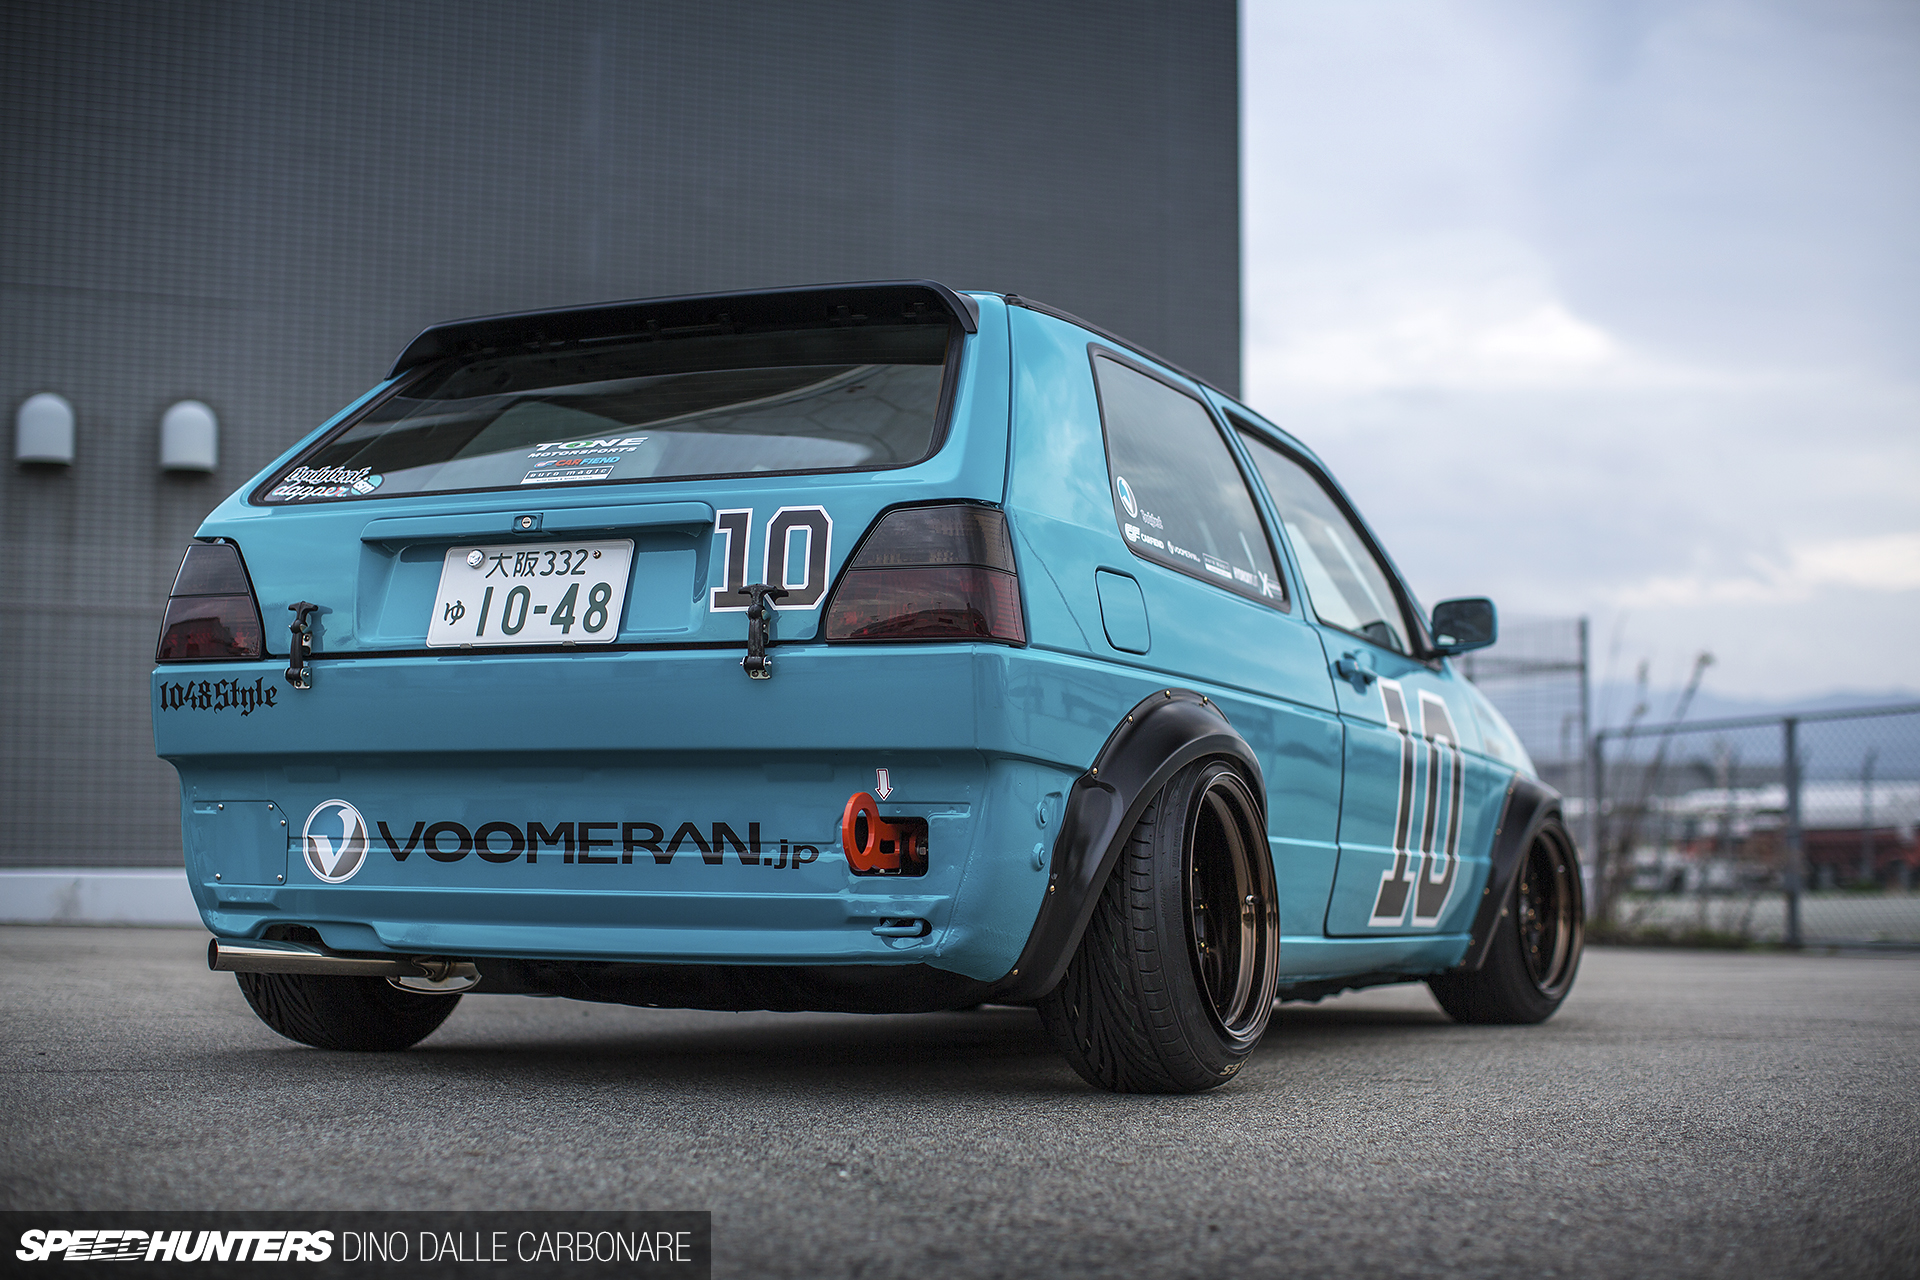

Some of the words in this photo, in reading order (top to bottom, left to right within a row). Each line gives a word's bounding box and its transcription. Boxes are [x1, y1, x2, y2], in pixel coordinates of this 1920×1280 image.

[527, 447, 637, 459] MOTORSPORTS
[535, 437, 649, 452] TONE
[529, 470, 560, 478] euro
[566, 467, 609, 478] magic
[710, 504, 834, 613] 10
[444, 600, 466, 625] ゆ
[476, 582, 613, 637] 10-48
[1367, 676, 1466, 928] 10
[376, 821, 820, 870] VOOMERAN.jp
